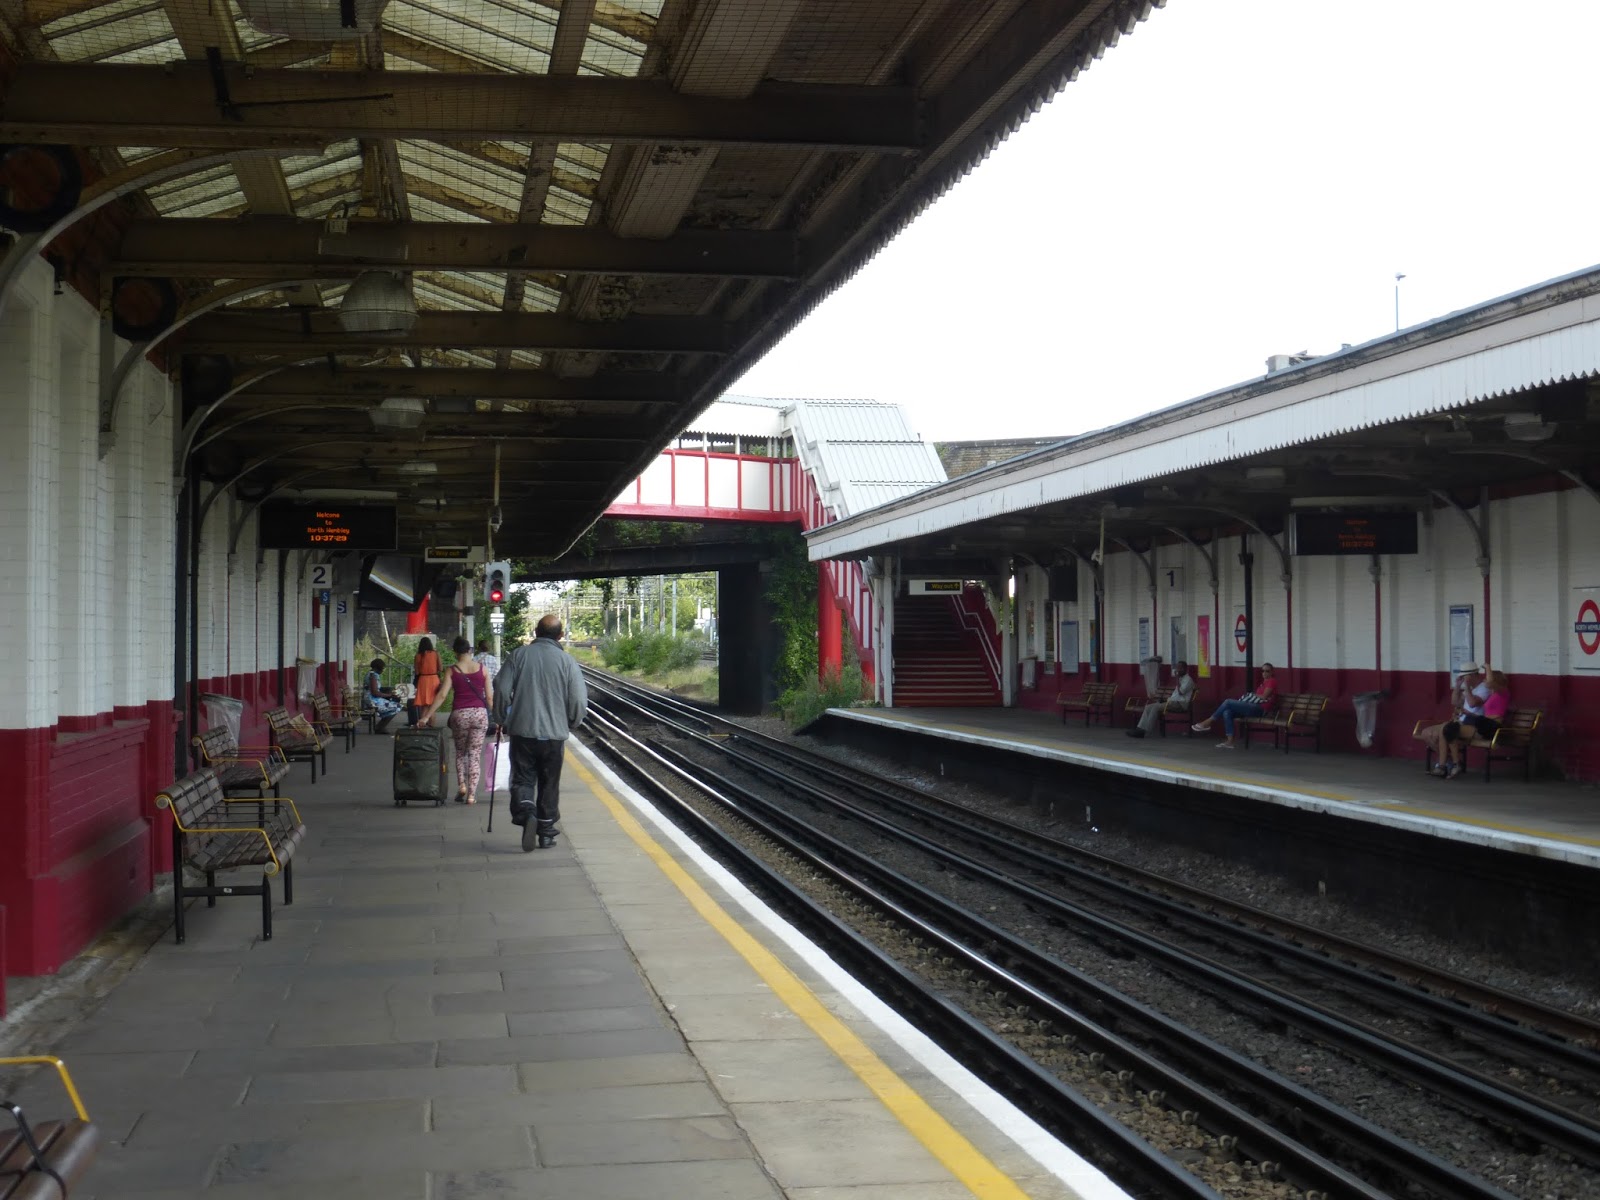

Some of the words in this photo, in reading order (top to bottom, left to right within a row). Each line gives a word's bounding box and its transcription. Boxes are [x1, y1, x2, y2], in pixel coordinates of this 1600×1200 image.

[326, 526, 351, 535] Wembley
[313, 566, 326, 584] 2
[1166, 570, 1174, 586] 1
[322, 592, 328, 602] S
